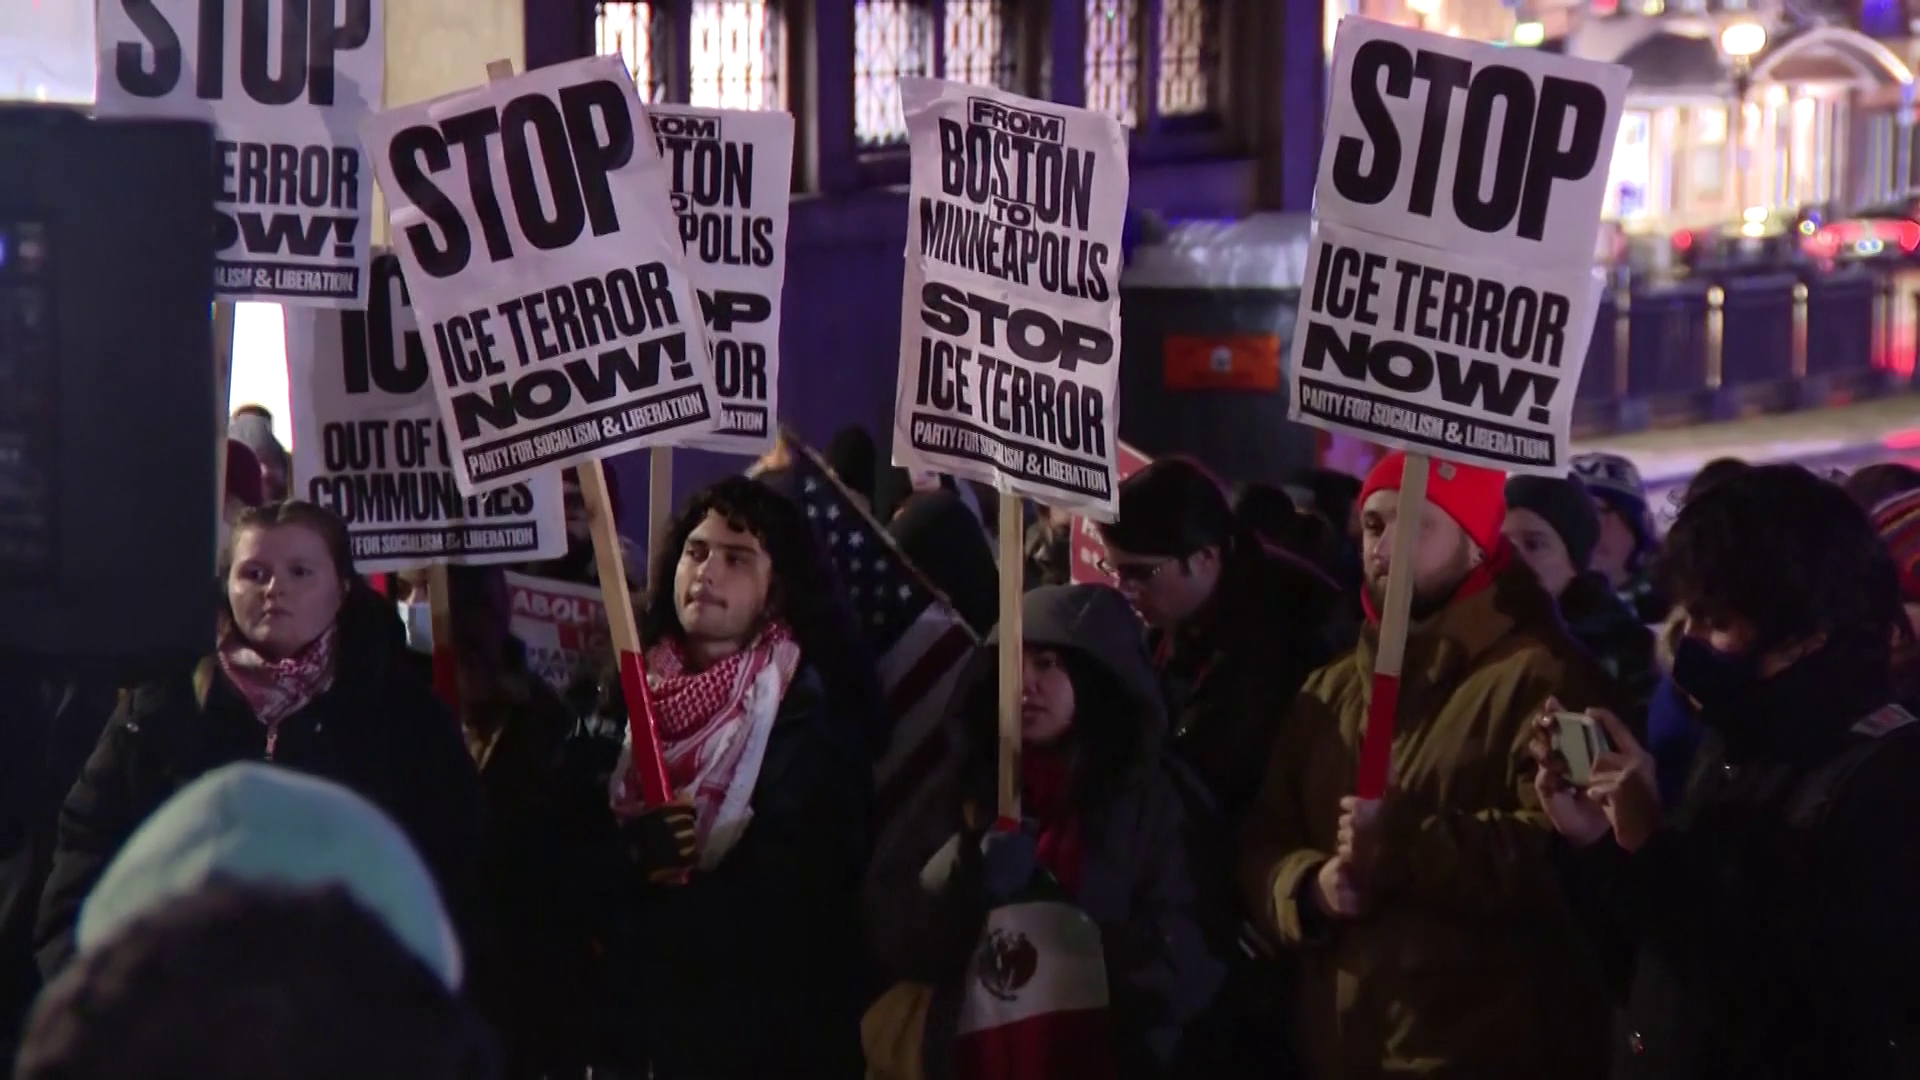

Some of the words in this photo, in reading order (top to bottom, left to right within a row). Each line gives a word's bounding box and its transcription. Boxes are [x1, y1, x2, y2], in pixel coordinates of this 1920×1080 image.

[115, 0, 371, 106] STOP
[973, 102, 1060, 141] FROM
[1332, 39, 1607, 242] STOP
[215, 140, 360, 210] ERROR
[388, 79, 635, 278] STOP
[656, 138, 754, 209] TON
[939, 117, 1096, 231] BOSTON
[993, 198, 1031, 228] TO
[254, 268, 273, 289] &
[275, 268, 354, 292] LIBERATION
[919, 197, 1110, 303] MINNEAPOLIS
[340, 254, 429, 394] IC
[433, 308, 504, 388] ICE
[497, 261, 680, 367] TERROR
[920, 281, 1114, 373] STOP
[1310, 243, 1388, 327] ICE
[1393, 260, 1570, 368] TERROR
[450, 332, 694, 441] NOW!
[915, 337, 973, 417] ICE
[976, 356, 1107, 458] TERROR
[1301, 320, 1560, 425] NOW!
[323, 420, 388, 472] OUT
[394, 418, 431, 469] OF
[467, 444, 510, 477] PARTY
[508, 438, 534, 466] FOR
[532, 419, 601, 460] SOCIALISM
[601, 416, 623, 438] &
[622, 392, 704, 433] LIBERATION
[719, 407, 764, 431] RATION
[914, 420, 958, 447] PARTY
[957, 429, 981, 453] FOR
[980, 434, 1025, 473] SOCIALISM
[1026, 453, 1042, 476] &
[1043, 456, 1107, 493] LIBERATION
[1302, 384, 1346, 416] PARTY
[1343, 397, 1371, 423] FOR
[1371, 402, 1444, 441] SOCIALISM
[1445, 421, 1463, 445] &
[1465, 424, 1551, 461] LIBERATION
[355, 534, 381, 556] FOR
[381, 532, 444, 554] SOCIALISM
[446, 532, 461, 550] &
[463, 527, 534, 549] LIBERATION
